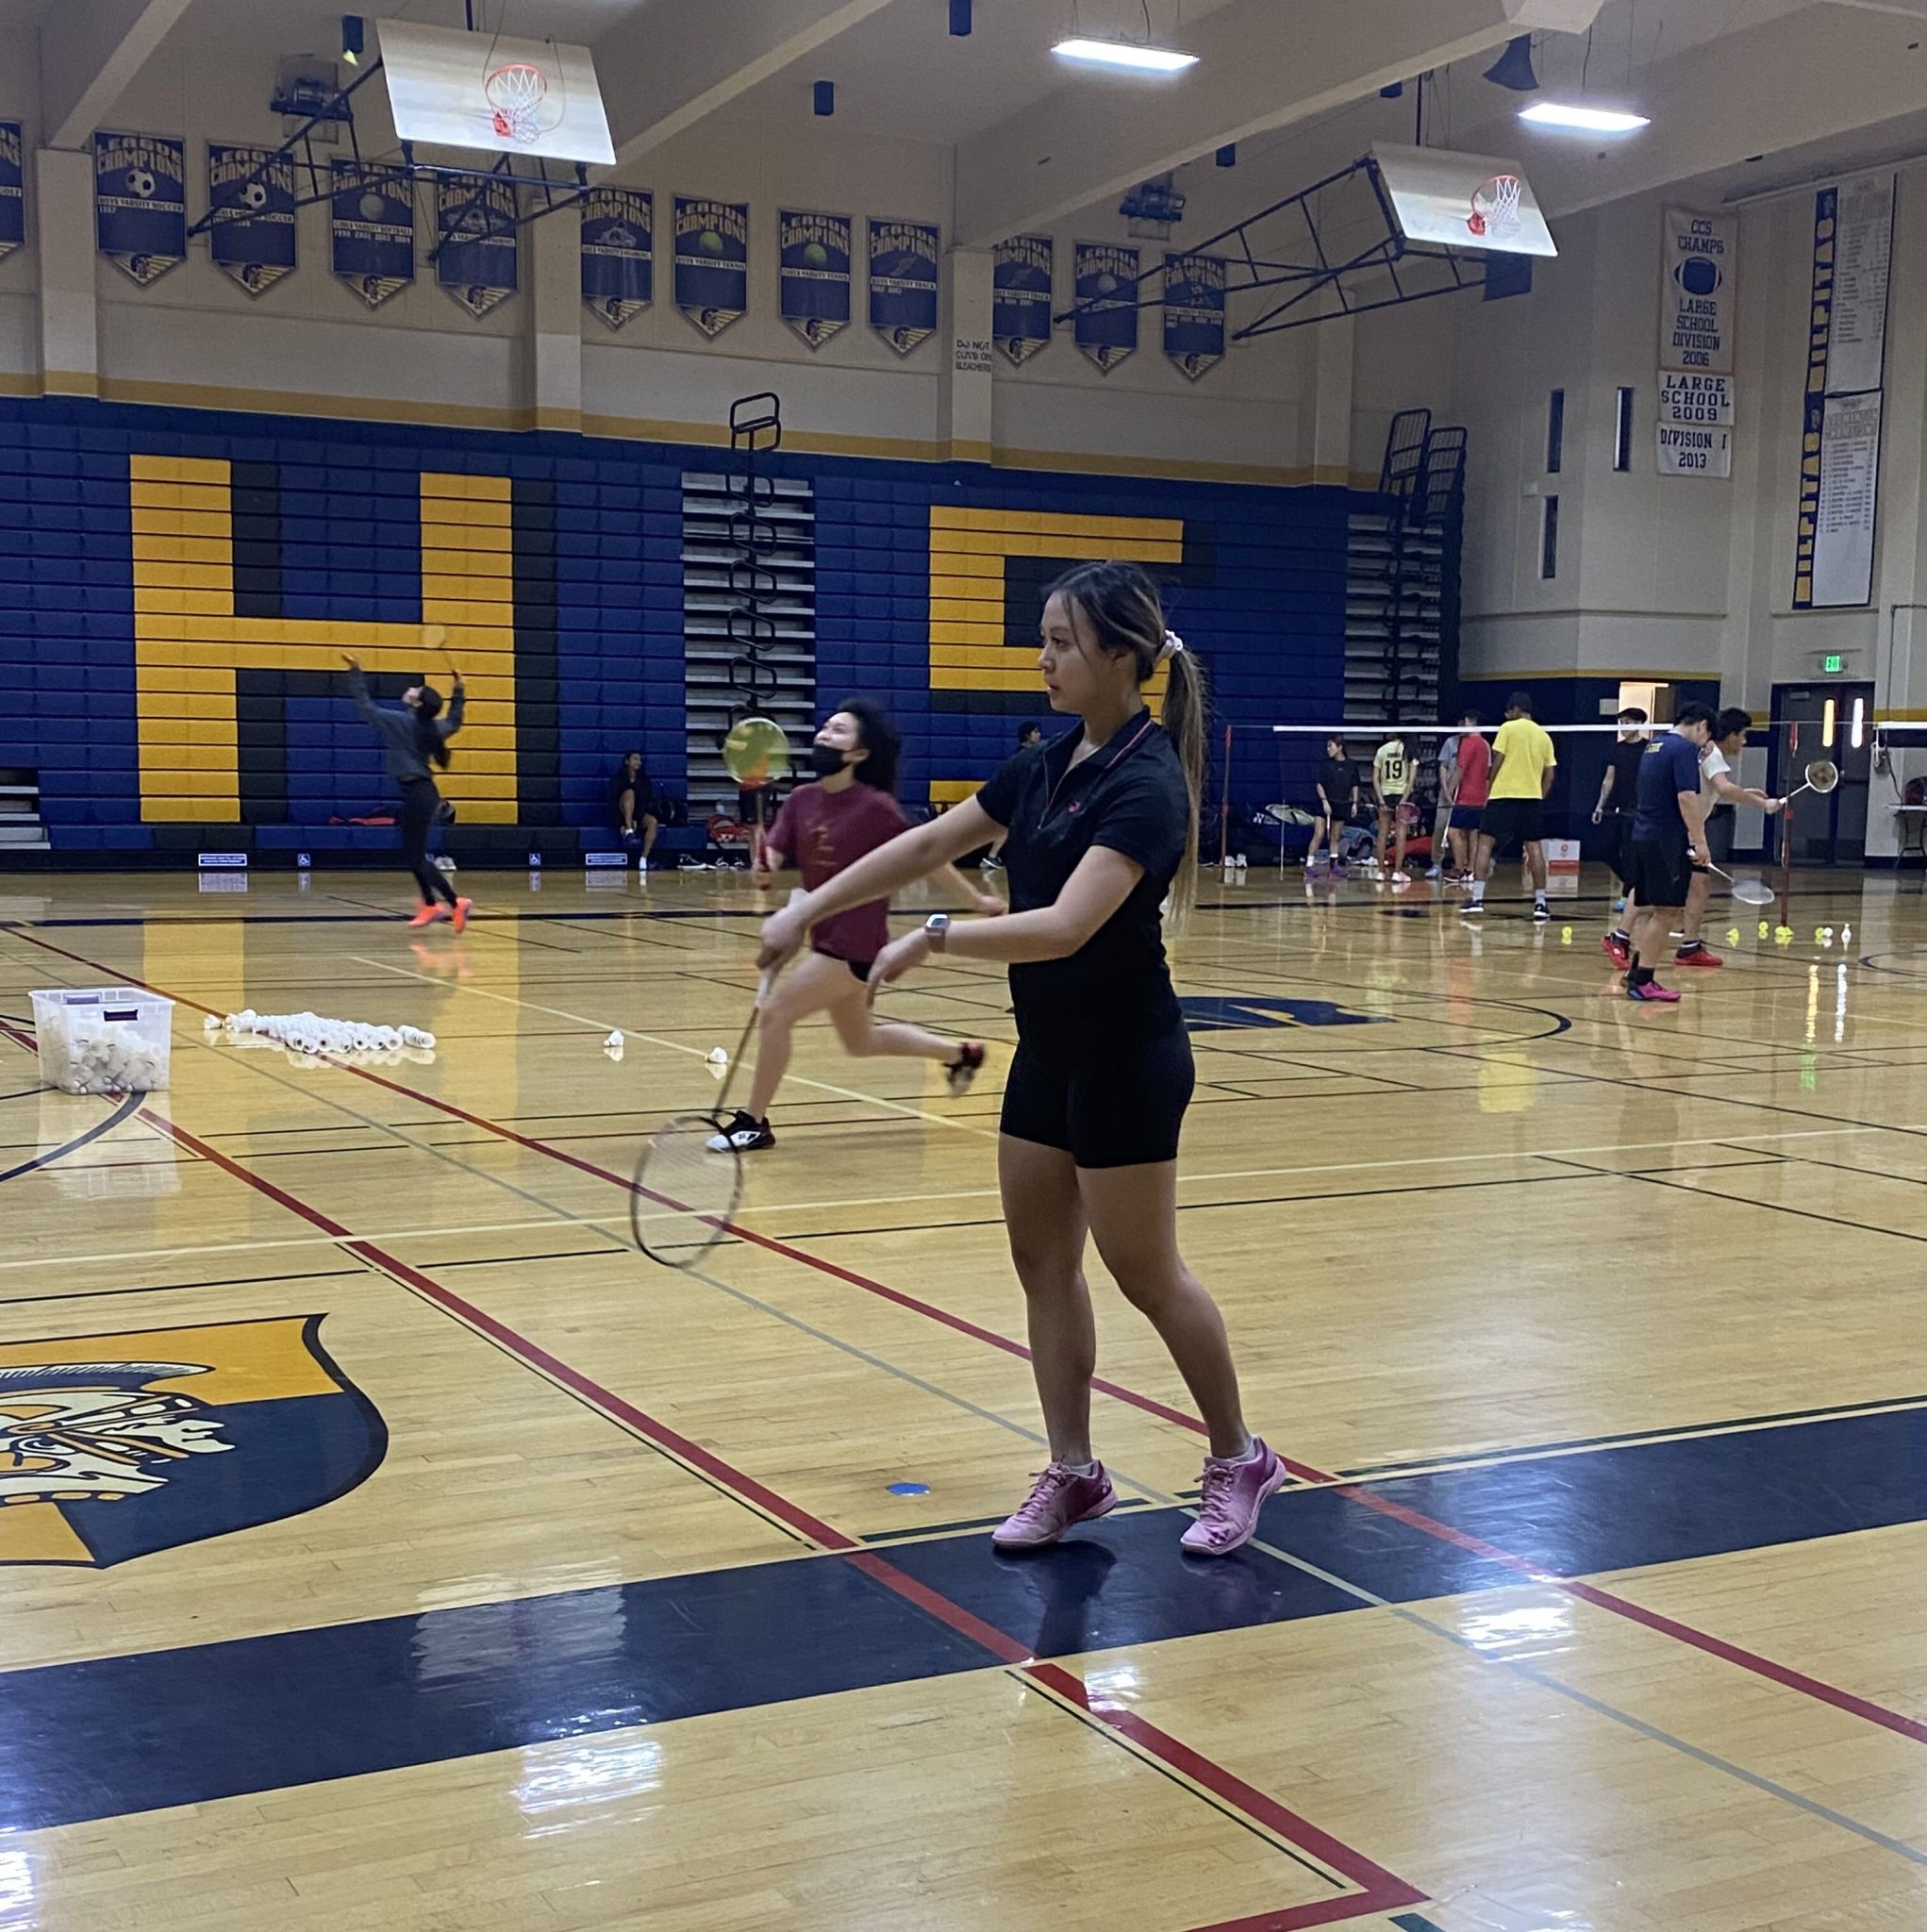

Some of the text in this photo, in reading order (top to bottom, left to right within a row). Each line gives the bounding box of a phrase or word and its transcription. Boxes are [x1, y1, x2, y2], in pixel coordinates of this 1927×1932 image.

[96, 137, 182, 161] LEAGUE
[97, 149, 183, 184] CHAMPIONS
[210, 151, 292, 173] LEAGE
[439, 188, 515, 220] CHAMIONS
[579, 190, 651, 214] EAGUE
[676, 202, 745, 226] LEAGUE
[676, 214, 745, 244] CHAMPIONS
[782, 215, 849, 240] LEAGUE
[871, 225, 936, 247] LEAGUE
[1691, 219, 1712, 236] CCS
[782, 226, 849, 257] CHAMPIONS
[871, 235, 936, 264] CHAMPIONS
[1678, 235, 1724, 254] CHAMPS
[994, 248, 1050, 275] HAMPIONS
[1679, 298, 1717, 315] LARGE
[1676, 315, 1719, 332] SCHOOL
[1672, 332, 1720, 351] DIVISION
[1683, 350, 1709, 366] 2006
[1666, 375, 1725, 391] LARGE
[1661, 390, 1730, 407] SCHOOL
[1672, 406, 1718, 421] 2009
[1660, 428, 1713, 449] DIVISION
[1678, 452, 1706, 469] 2013
[130, 455, 517, 824] H
[1385, 760, 1403, 779] 19
